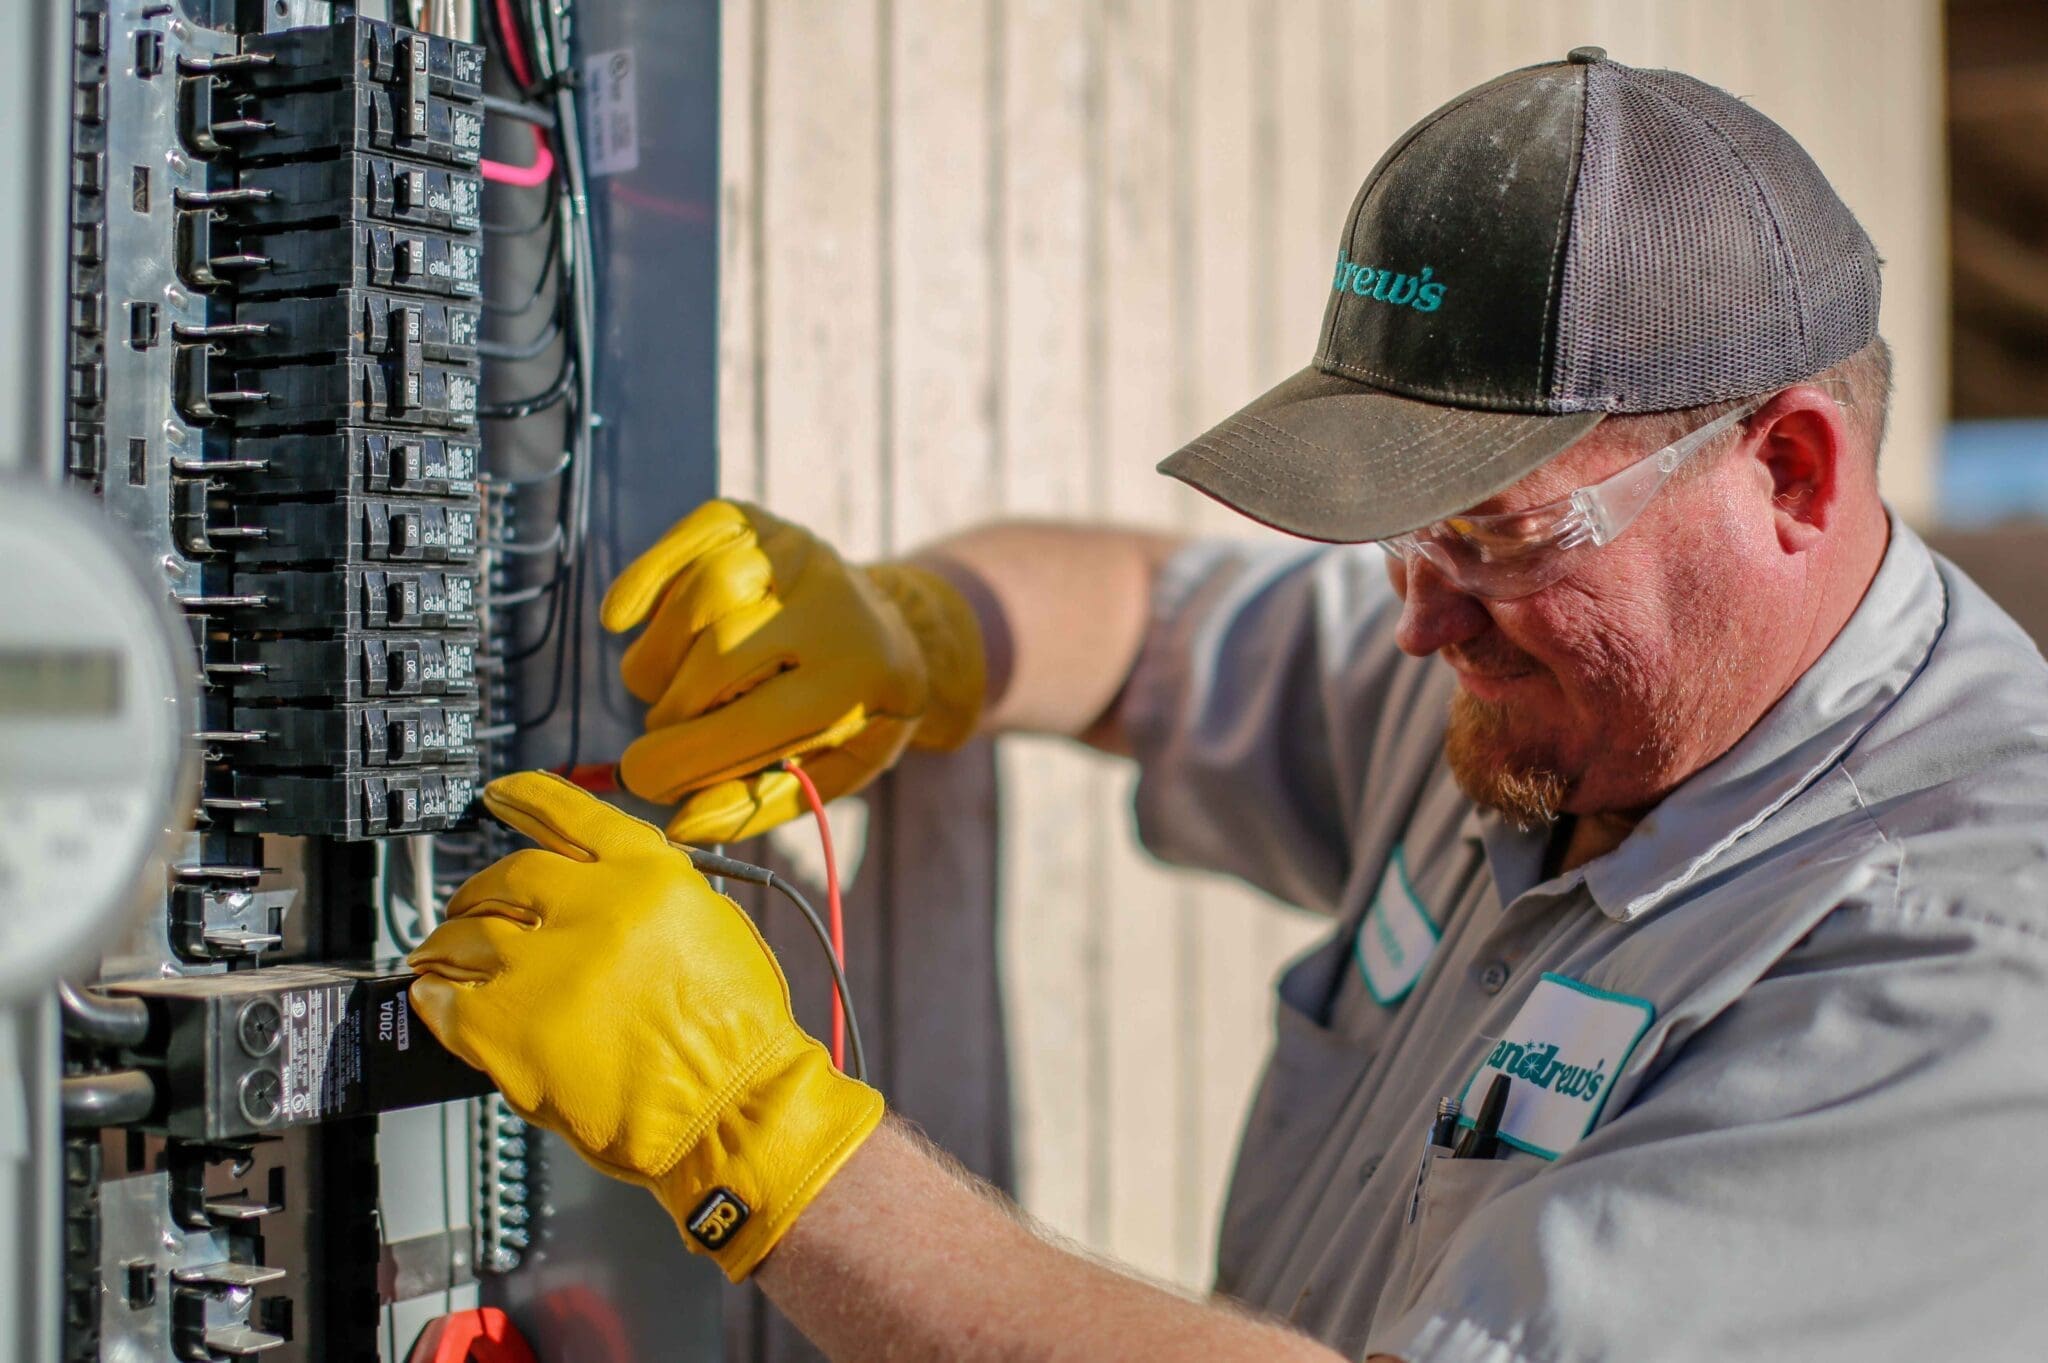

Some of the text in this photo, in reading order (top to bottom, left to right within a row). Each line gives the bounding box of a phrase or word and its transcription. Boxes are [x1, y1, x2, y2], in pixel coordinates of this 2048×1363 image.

[415, 51, 424, 64] 50
[415, 108, 424, 120] 50
[413, 181, 422, 193] 15
[413, 250, 422, 263] 15
[410, 323, 418, 335] 50
[409, 381, 417, 394] 50
[409, 459, 417, 471] 15
[408, 525, 416, 537] 20
[407, 591, 415, 604] 20
[407, 660, 415, 673] 20
[407, 730, 415, 743] 20
[407, 798, 416, 810] 20
[379, 1000, 394, 1041] 200A
[1486, 1039, 1604, 1102] andrew's
[282, 1066, 290, 1114] SIEMENS
